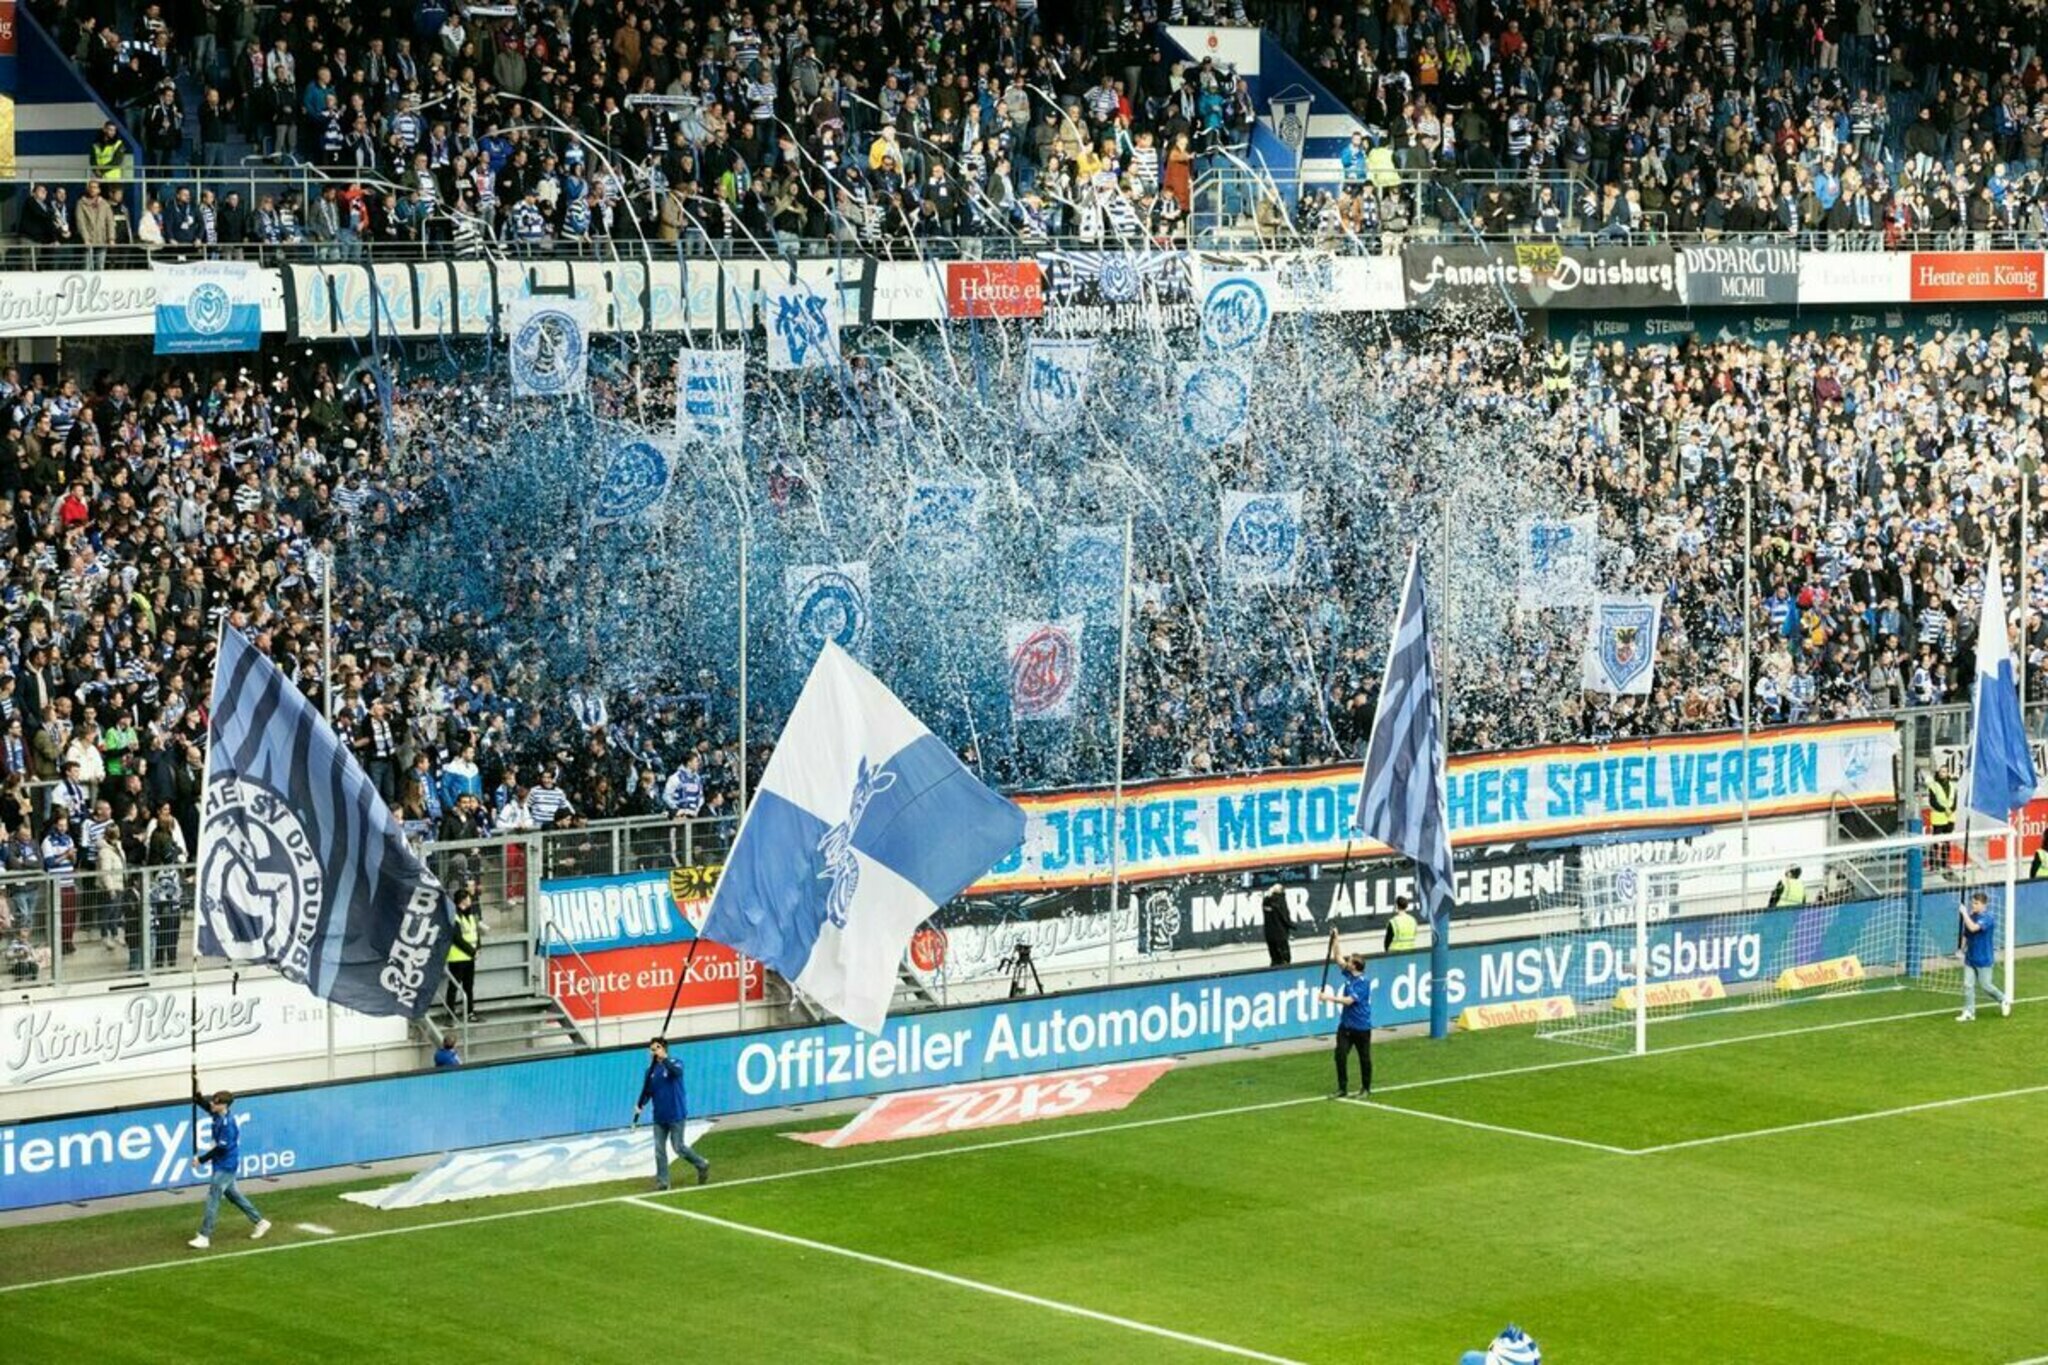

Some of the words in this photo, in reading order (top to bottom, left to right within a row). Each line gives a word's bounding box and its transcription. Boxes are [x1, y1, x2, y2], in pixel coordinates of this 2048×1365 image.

[1547, 256, 1674, 291] Duisburg
[1685, 246, 1798, 274] DISPARGUM
[1919, 265, 1964, 287] Heute
[1966, 267, 1992, 287] ein
[1994, 264, 2038, 292] König
[0, 280, 59, 326] önig
[58, 273, 157, 317] Pilsene
[959, 277, 1020, 301] Heute
[1721, 276, 1766, 298] MCMII
[1043, 799, 1200, 871] JAHRE
[1546, 741, 1819, 818] SPIELVEREIN
[540, 880, 673, 943] RUHRPOTT
[1191, 886, 1315, 933] IMMR
[552, 968, 630, 998] Heute
[636, 962, 674, 988] ein
[683, 954, 757, 990] König
[7, 1007, 124, 1071] König
[120, 992, 262, 1046] Pilsener
[736, 1023, 972, 1096] Offizieller
[1480, 944, 1574, 999] MSV
